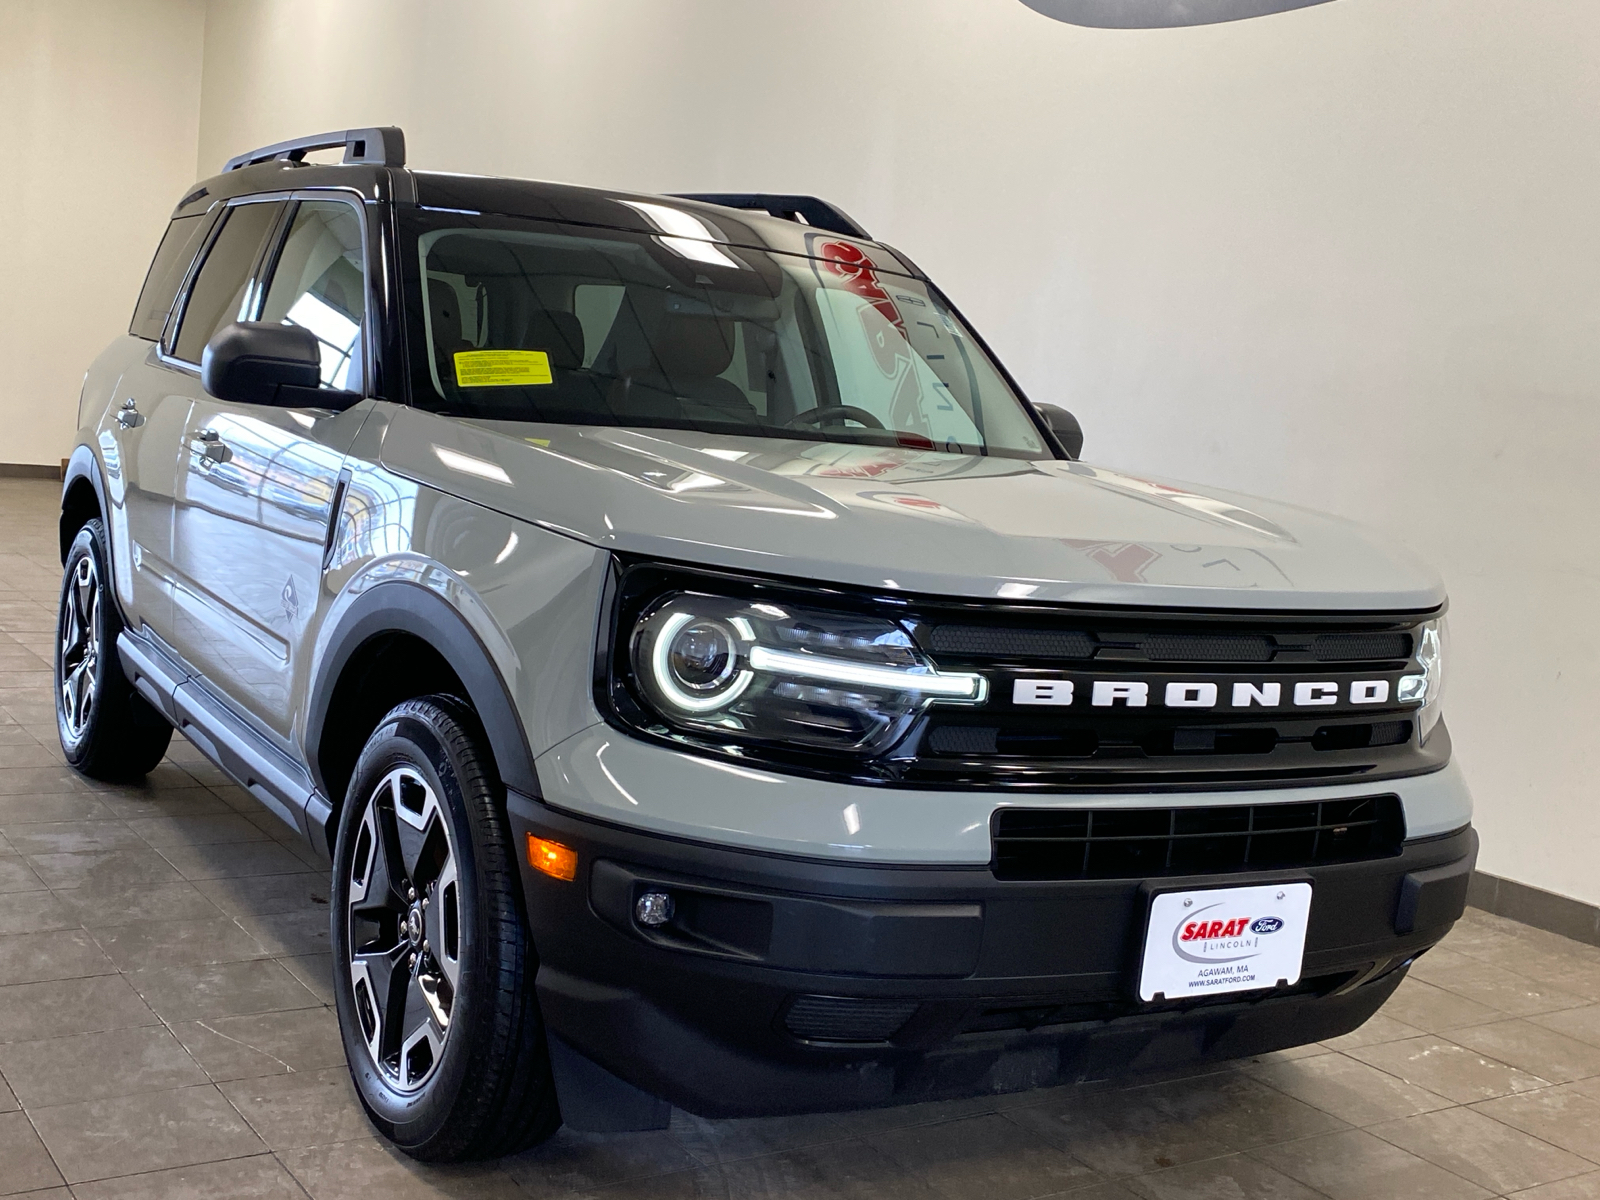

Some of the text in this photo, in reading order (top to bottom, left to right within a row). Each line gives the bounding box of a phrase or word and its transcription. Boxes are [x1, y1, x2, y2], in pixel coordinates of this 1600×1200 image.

[1012, 679, 1390, 707] BRONCO
[1181, 918, 1280, 941] SARAT Ford
[1210, 939, 1252, 950] LINCOLN
[1198, 964, 1249, 977] AGAWAM, MA
[1188, 975, 1255, 987] WWW.SARATFORD.COM
